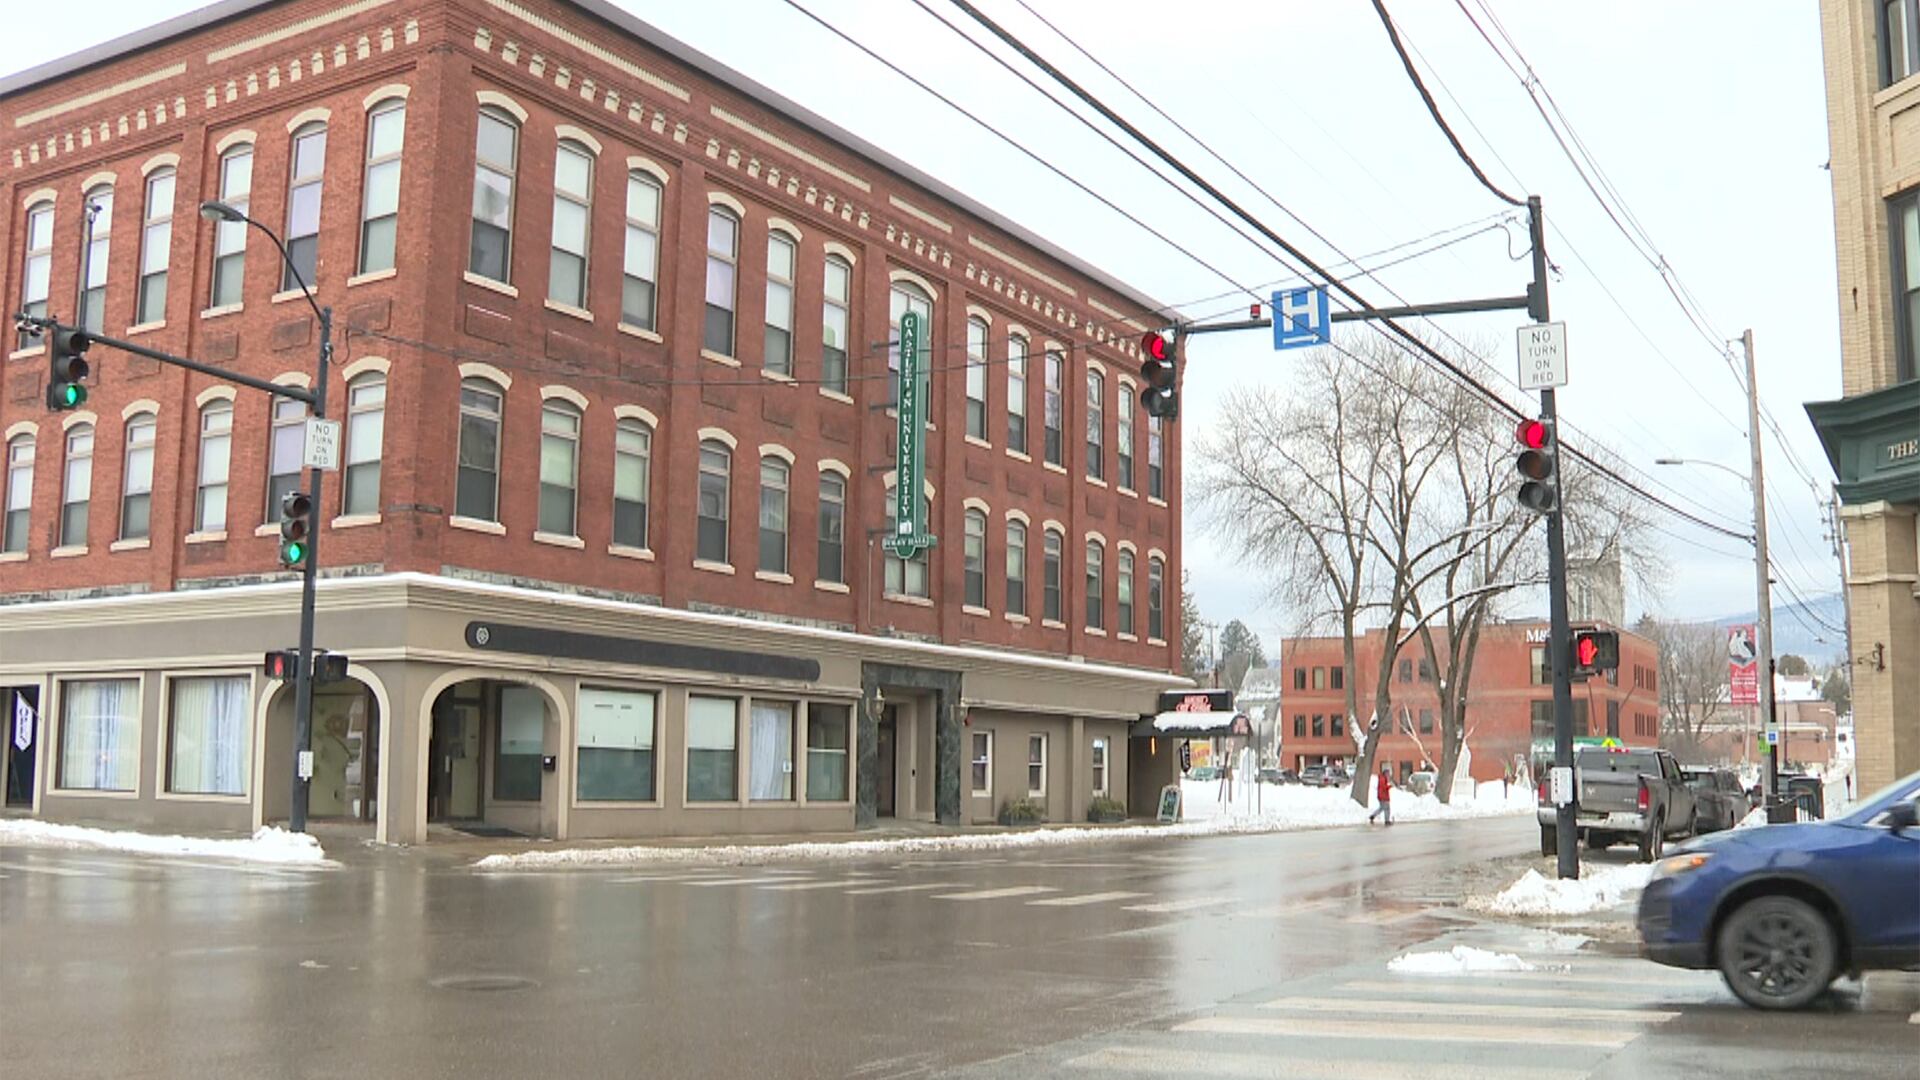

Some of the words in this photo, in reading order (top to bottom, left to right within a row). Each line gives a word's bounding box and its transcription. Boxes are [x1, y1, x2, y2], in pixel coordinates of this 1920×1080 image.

[1282, 290, 1319, 332] H
[1531, 329, 1551, 344] NO
[1528, 344, 1557, 358] TURN
[903, 317, 914, 409] CASTLETON
[1535, 359, 1550, 370] ON
[1532, 371, 1554, 384] RED
[315, 424, 330, 436] NO
[312, 434, 333, 446] TURN
[316, 445, 328, 455] ON
[1888, 439, 1918, 459] THE
[313, 455, 329, 465] RED
[901, 413, 912, 516] UNIVERSITY
[1526, 628, 1550, 643] M&
